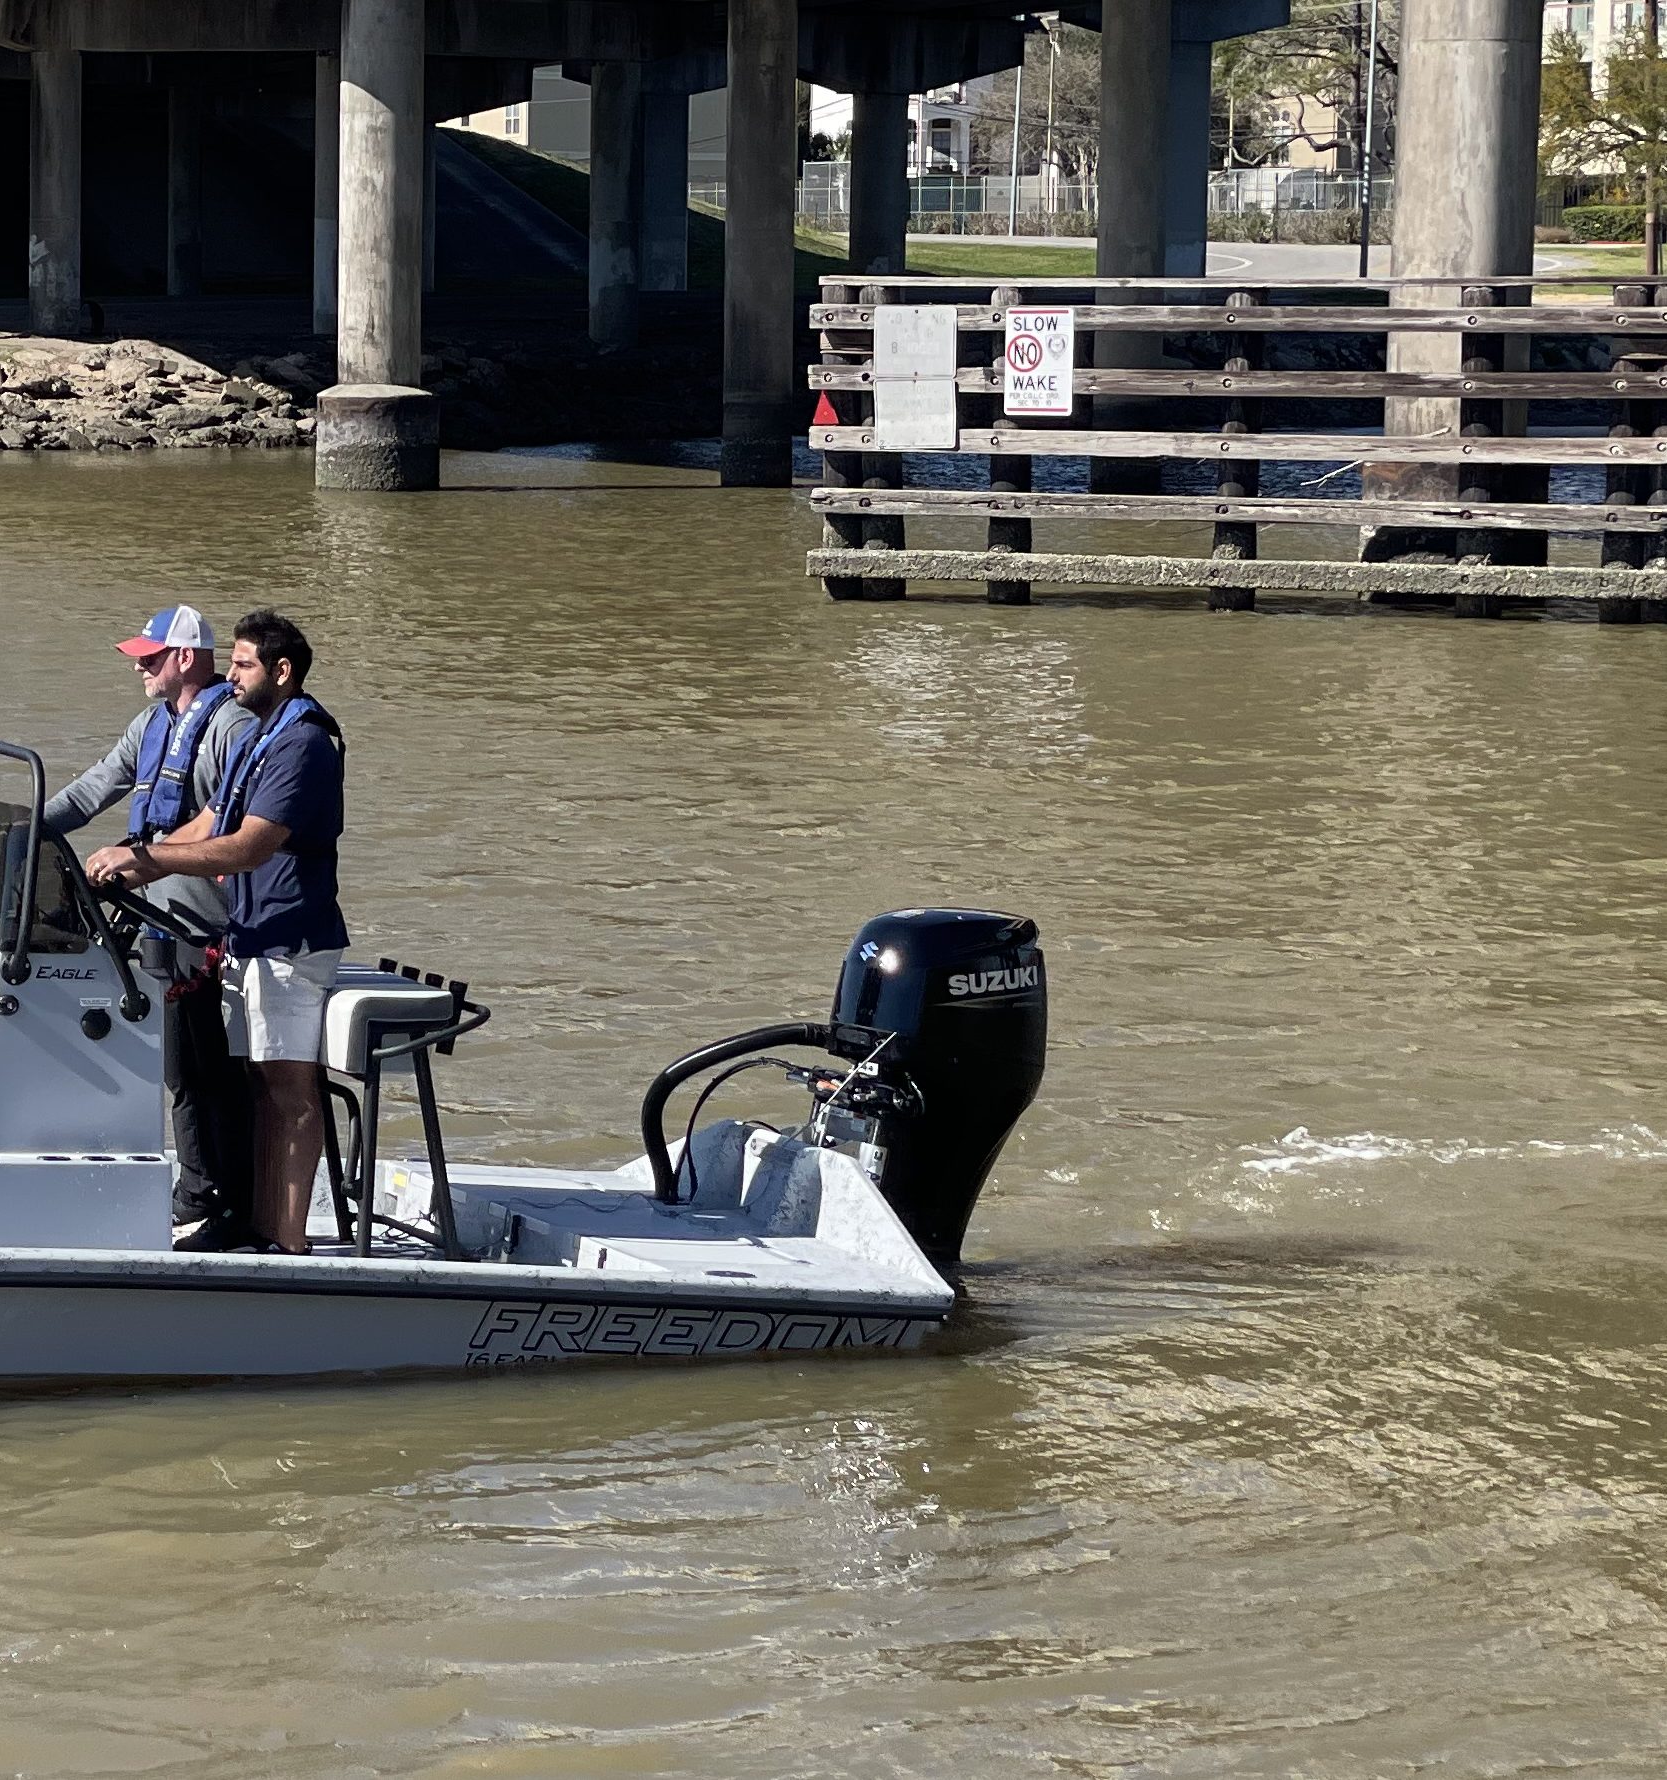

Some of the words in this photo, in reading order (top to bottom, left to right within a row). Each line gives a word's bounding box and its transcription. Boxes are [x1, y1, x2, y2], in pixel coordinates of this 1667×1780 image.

[1013, 316, 1058, 331] SLOW
[1014, 342, 1038, 365] NO
[1013, 376, 1057, 391] WAKE
[36, 965, 98, 980] EAGLE
[948, 966, 1038, 996] SUZUKI
[469, 1301, 911, 1356] FREEDOM
